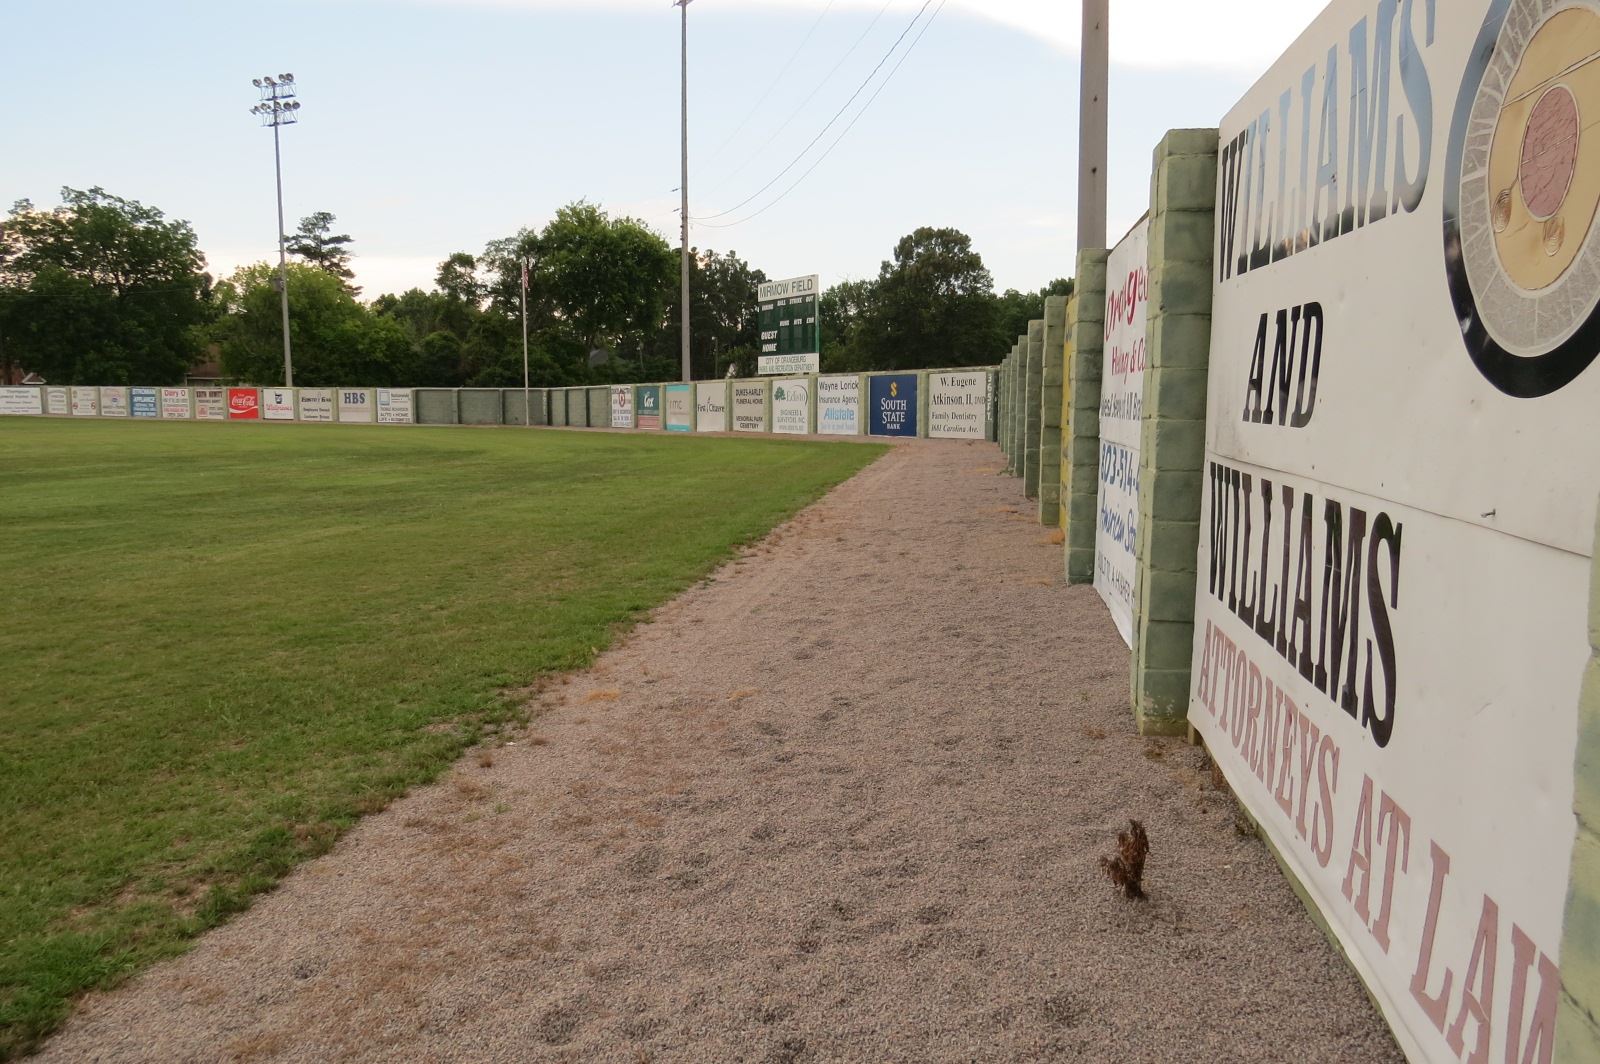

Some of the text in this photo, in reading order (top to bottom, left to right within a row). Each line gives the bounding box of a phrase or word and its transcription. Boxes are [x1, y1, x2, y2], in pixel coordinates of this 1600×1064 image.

[1219, 0, 1436, 283] WILLIAMS
[760, 278, 812, 298] MIRMOW FIELD
[760, 330, 778, 340] GUEST
[762, 343, 778, 352] HOME
[1242, 301, 1324, 428] AND
[818, 380, 859, 392] Wayne Lorick
[940, 376, 976, 388] W. Eugene
[232, 396, 256, 406] Coca-Cola
[344, 392, 366, 404] HBS
[818, 395, 859, 406] Insurance Agency
[880, 398, 907, 410] SOUTH
[824, 408, 854, 420] Allstate
[882, 412, 906, 424] STATE
[932, 412, 976, 422] Family Dentistry
[1208, 461, 1403, 748] WILLIAMS
[1197, 618, 1340, 869] ATTORNEYS
[1341, 772, 1412, 956] AT
